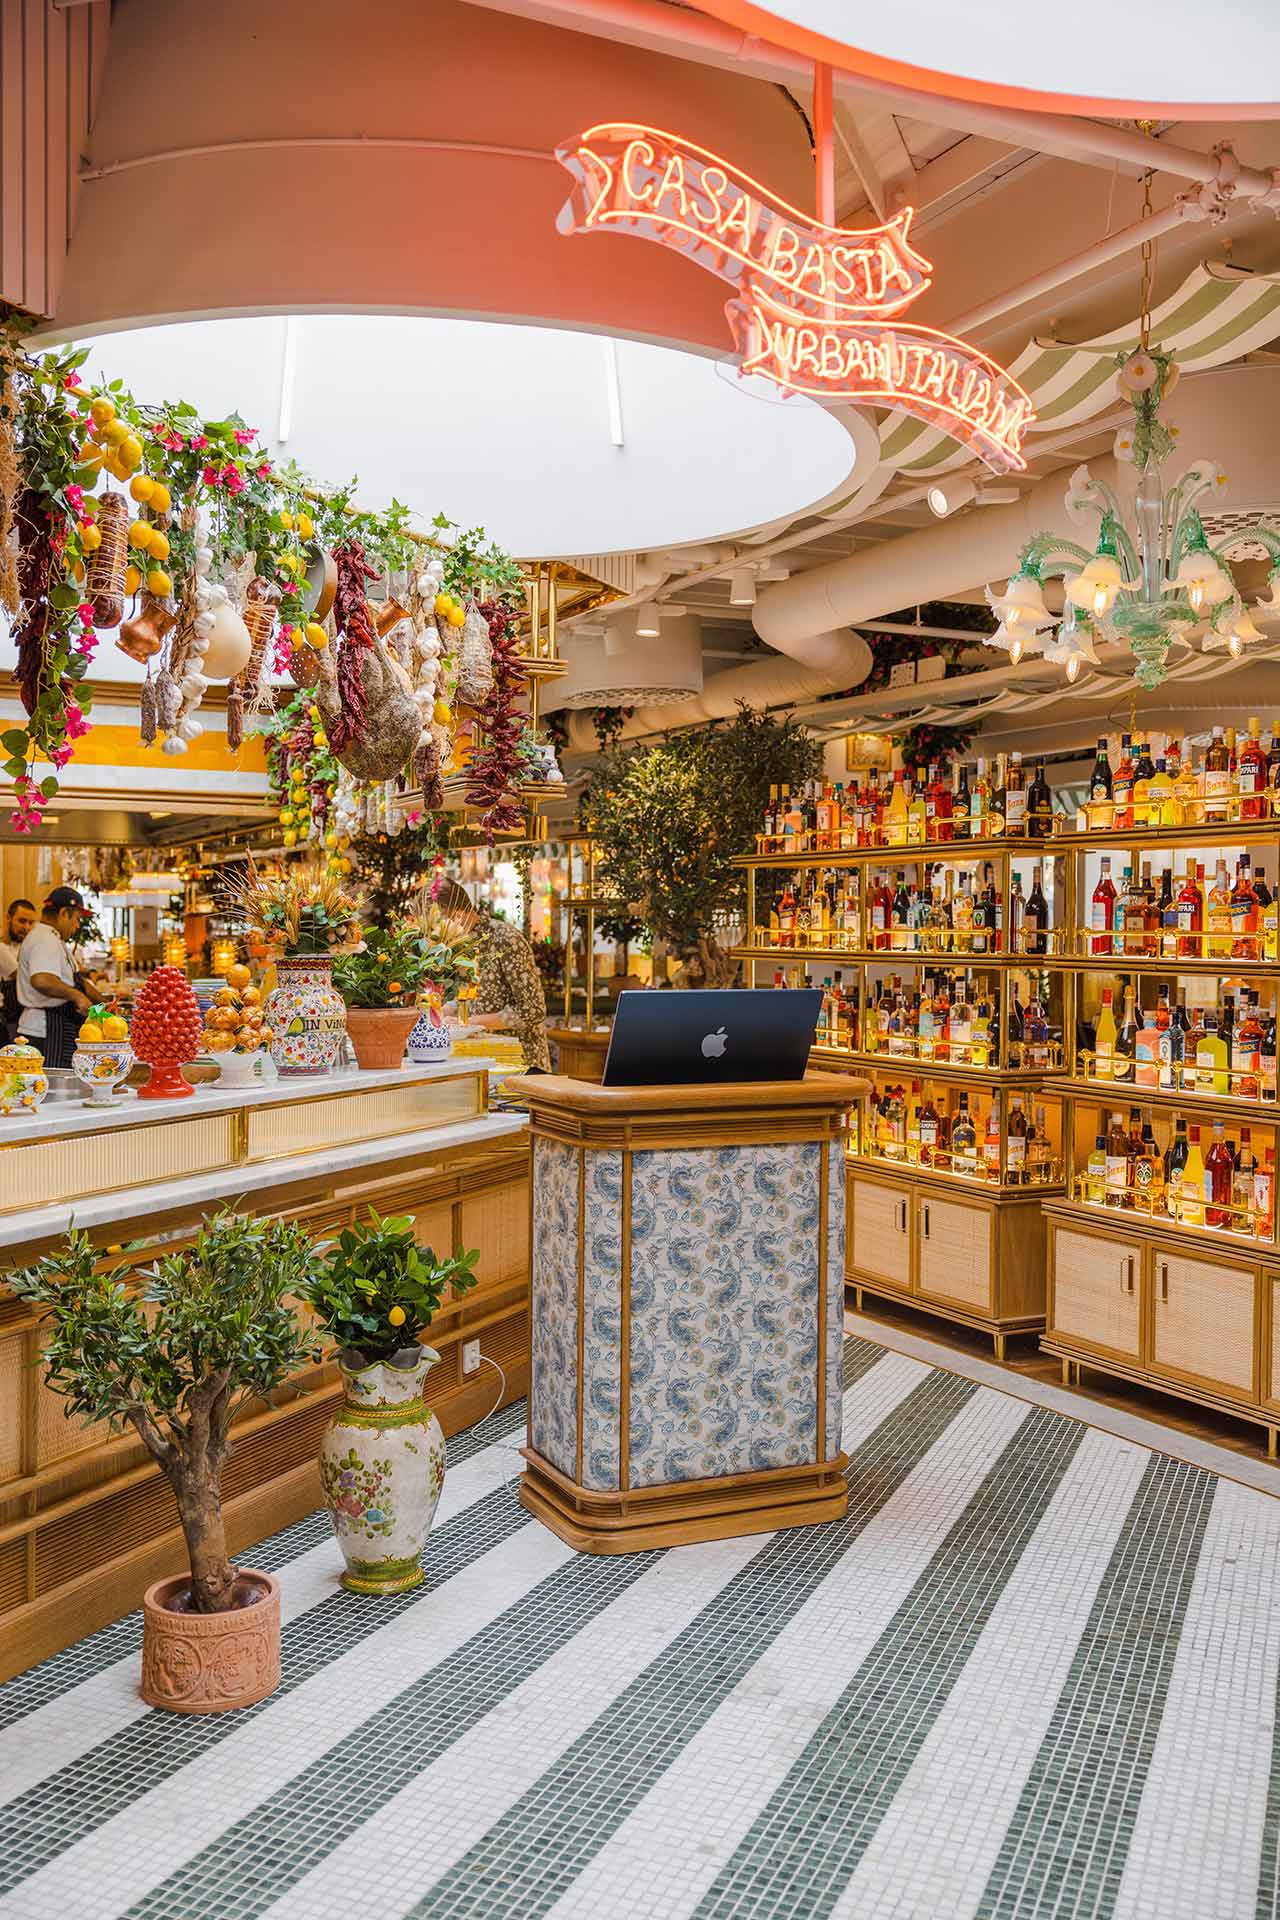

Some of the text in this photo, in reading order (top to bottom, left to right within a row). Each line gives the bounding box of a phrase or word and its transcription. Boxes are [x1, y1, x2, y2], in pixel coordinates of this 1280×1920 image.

[622, 140, 913, 299] CASA BASTA
[774, 322, 1025, 440] URBAN ITALIAN
[305, 1019, 320, 1030] IN
